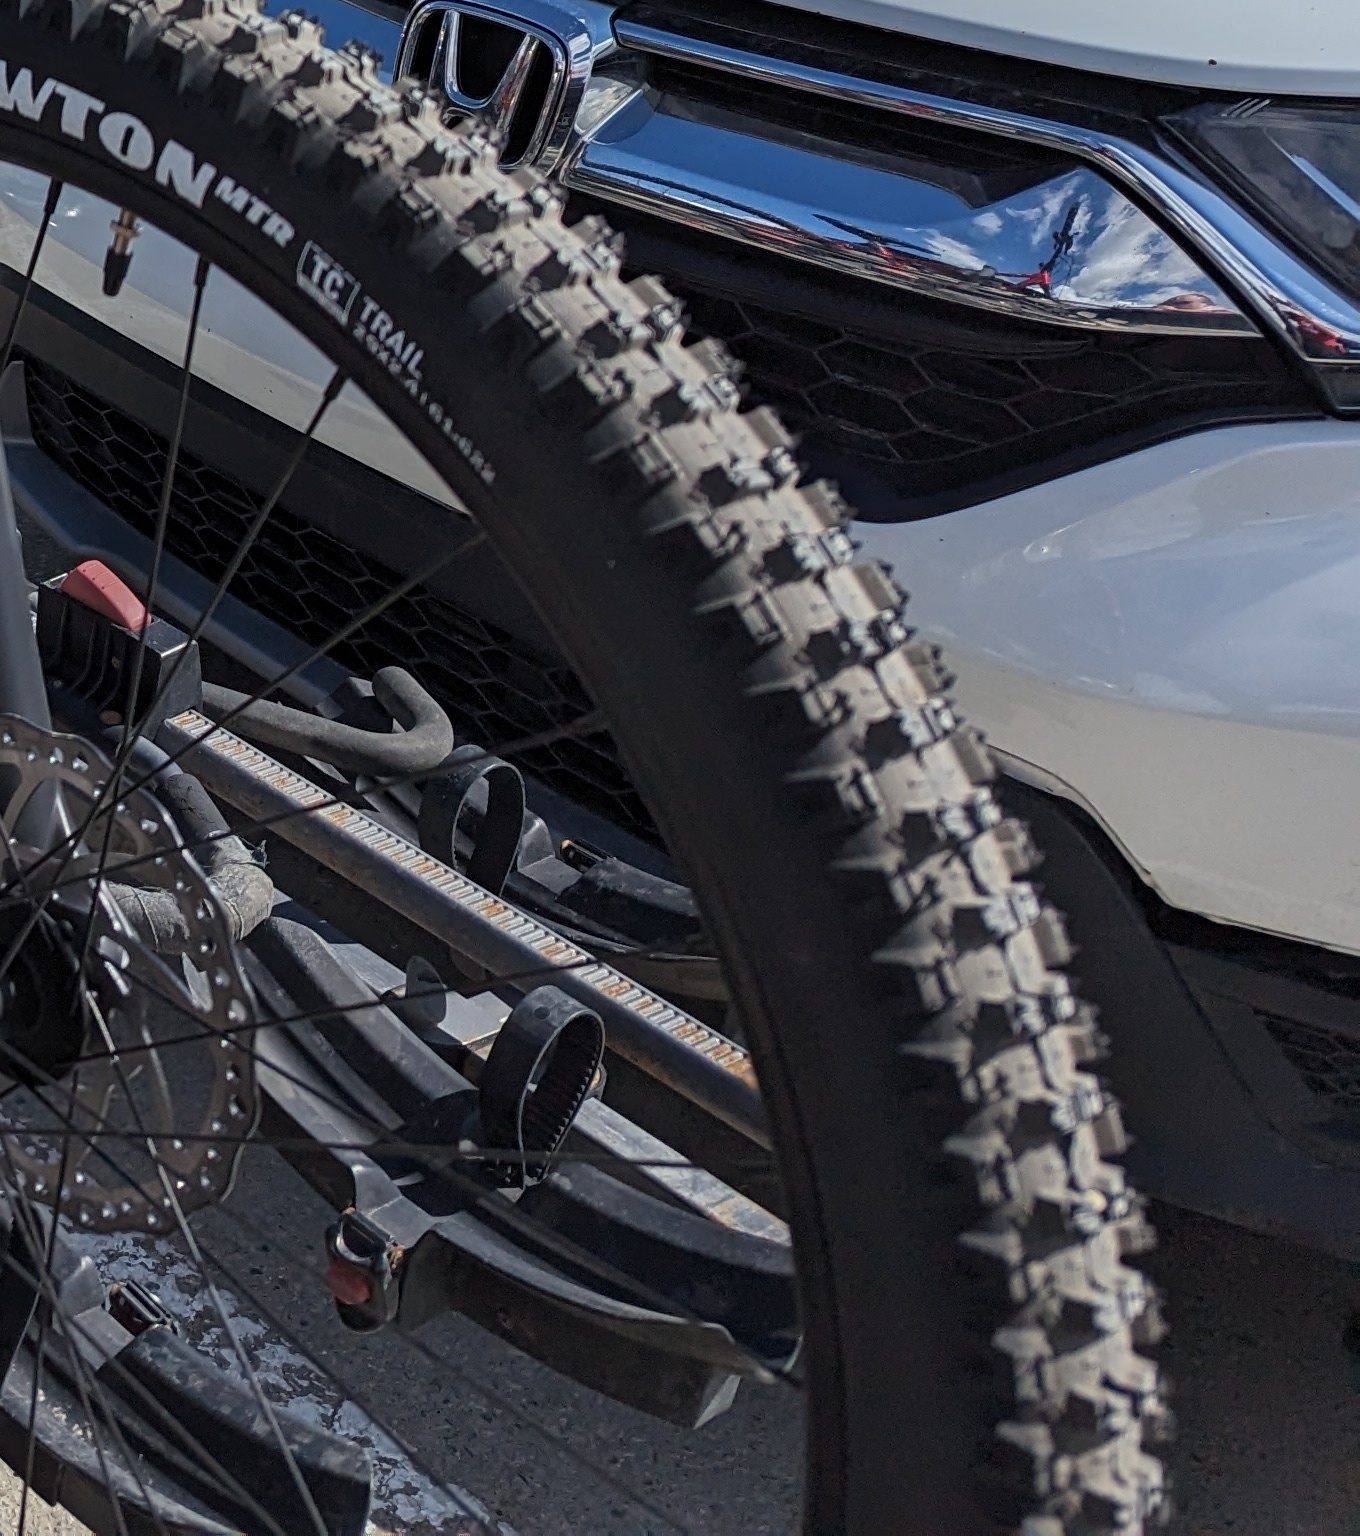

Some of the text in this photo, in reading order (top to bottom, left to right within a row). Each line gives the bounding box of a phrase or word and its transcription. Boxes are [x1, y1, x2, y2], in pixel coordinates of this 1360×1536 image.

[213, 176, 297, 248] MTR
[310, 253, 346, 301] TC
[357, 295, 426, 381] TRAIL
